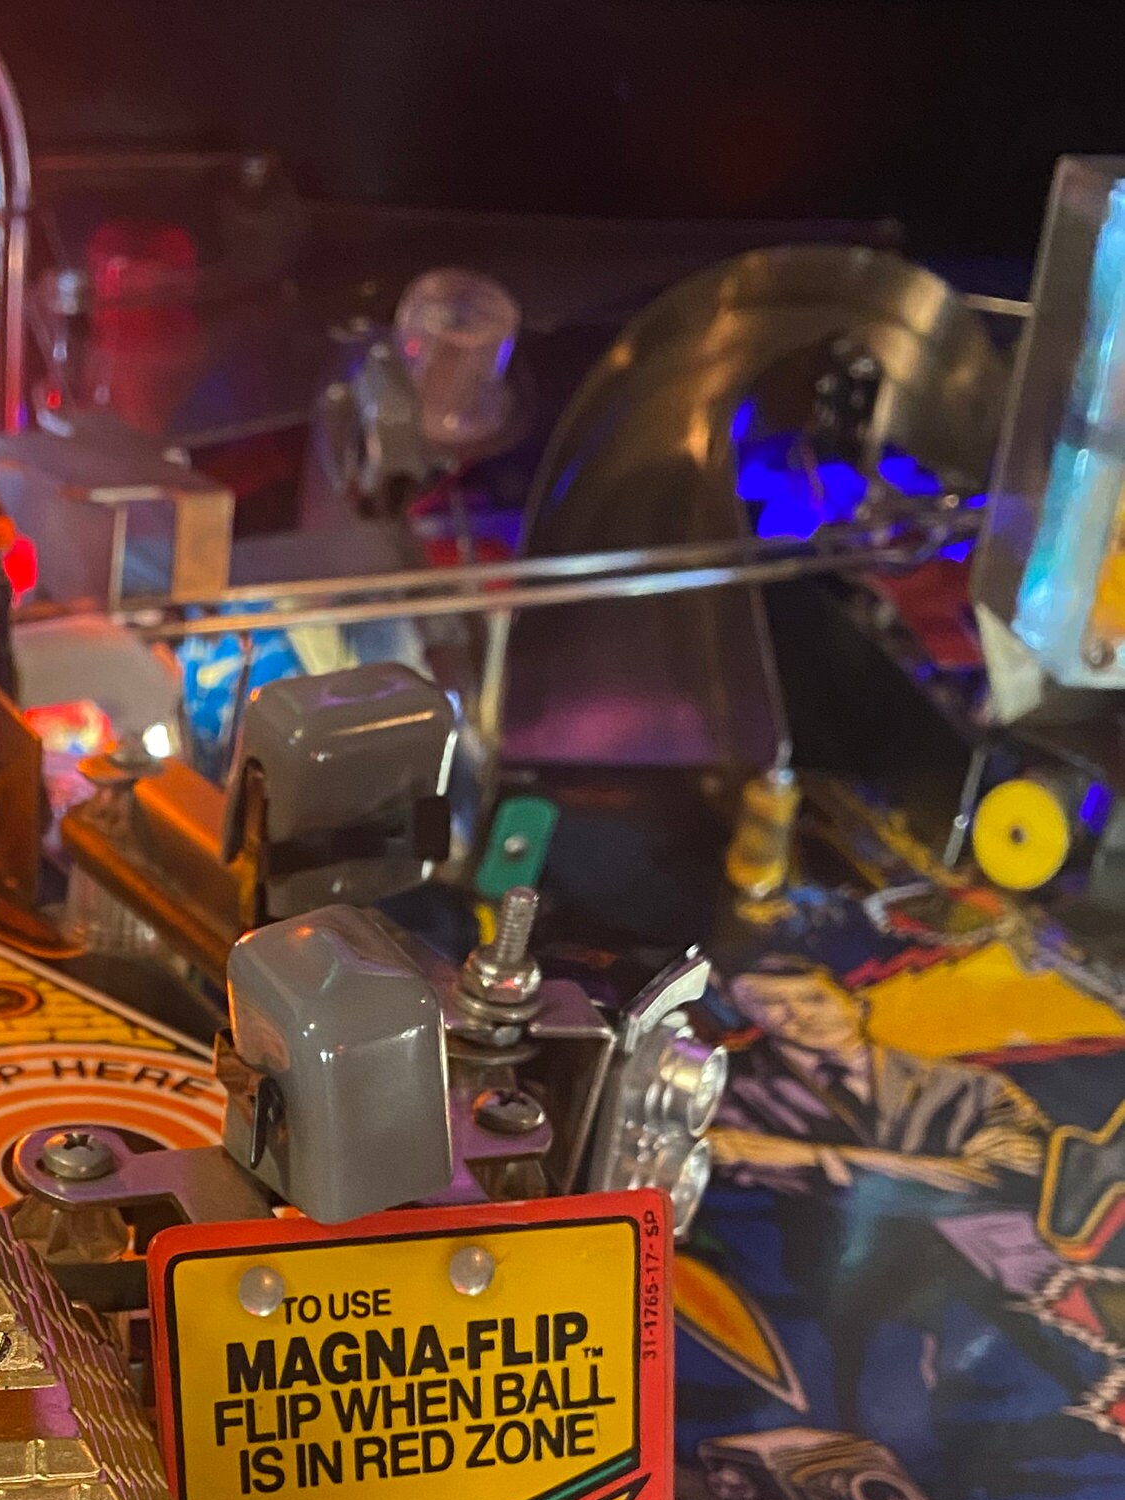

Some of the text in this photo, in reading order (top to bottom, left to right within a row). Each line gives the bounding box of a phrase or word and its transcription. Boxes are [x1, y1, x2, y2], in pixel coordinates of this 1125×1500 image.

[51, 1059, 213, 1100] HERE
[282, 1288, 392, 1325] TO USE
[213, 1364, 616, 1447] FLIP WHEN BALL
[239, 1412, 597, 1495] IS IN RED ZONE
